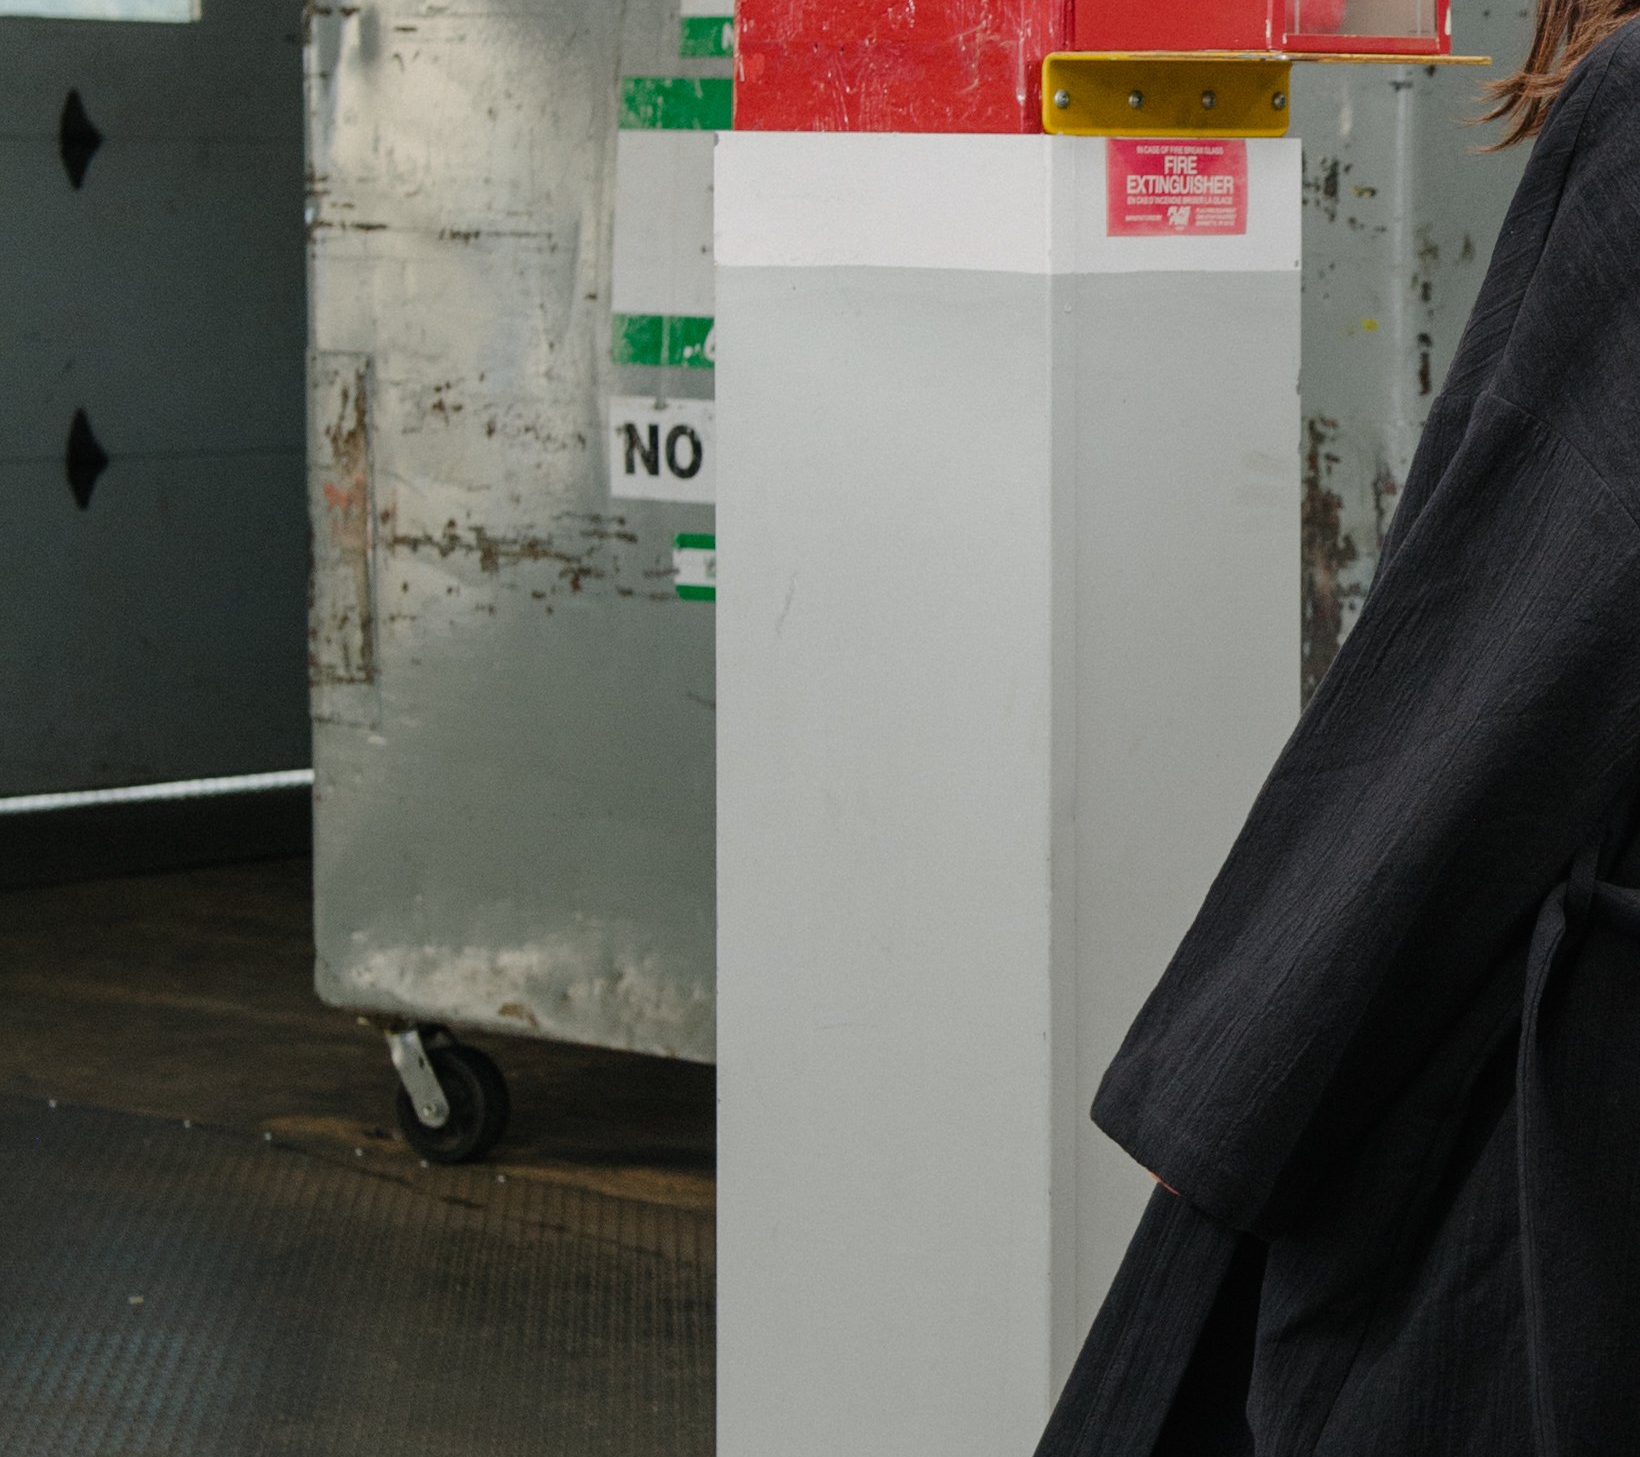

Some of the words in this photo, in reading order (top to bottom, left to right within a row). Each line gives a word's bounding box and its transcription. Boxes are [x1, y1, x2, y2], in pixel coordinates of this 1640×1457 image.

[1164, 155, 1198, 174] FIRE
[1126, 175, 1235, 194] EXTINGUISHER
[622, 423, 703, 479] NO
